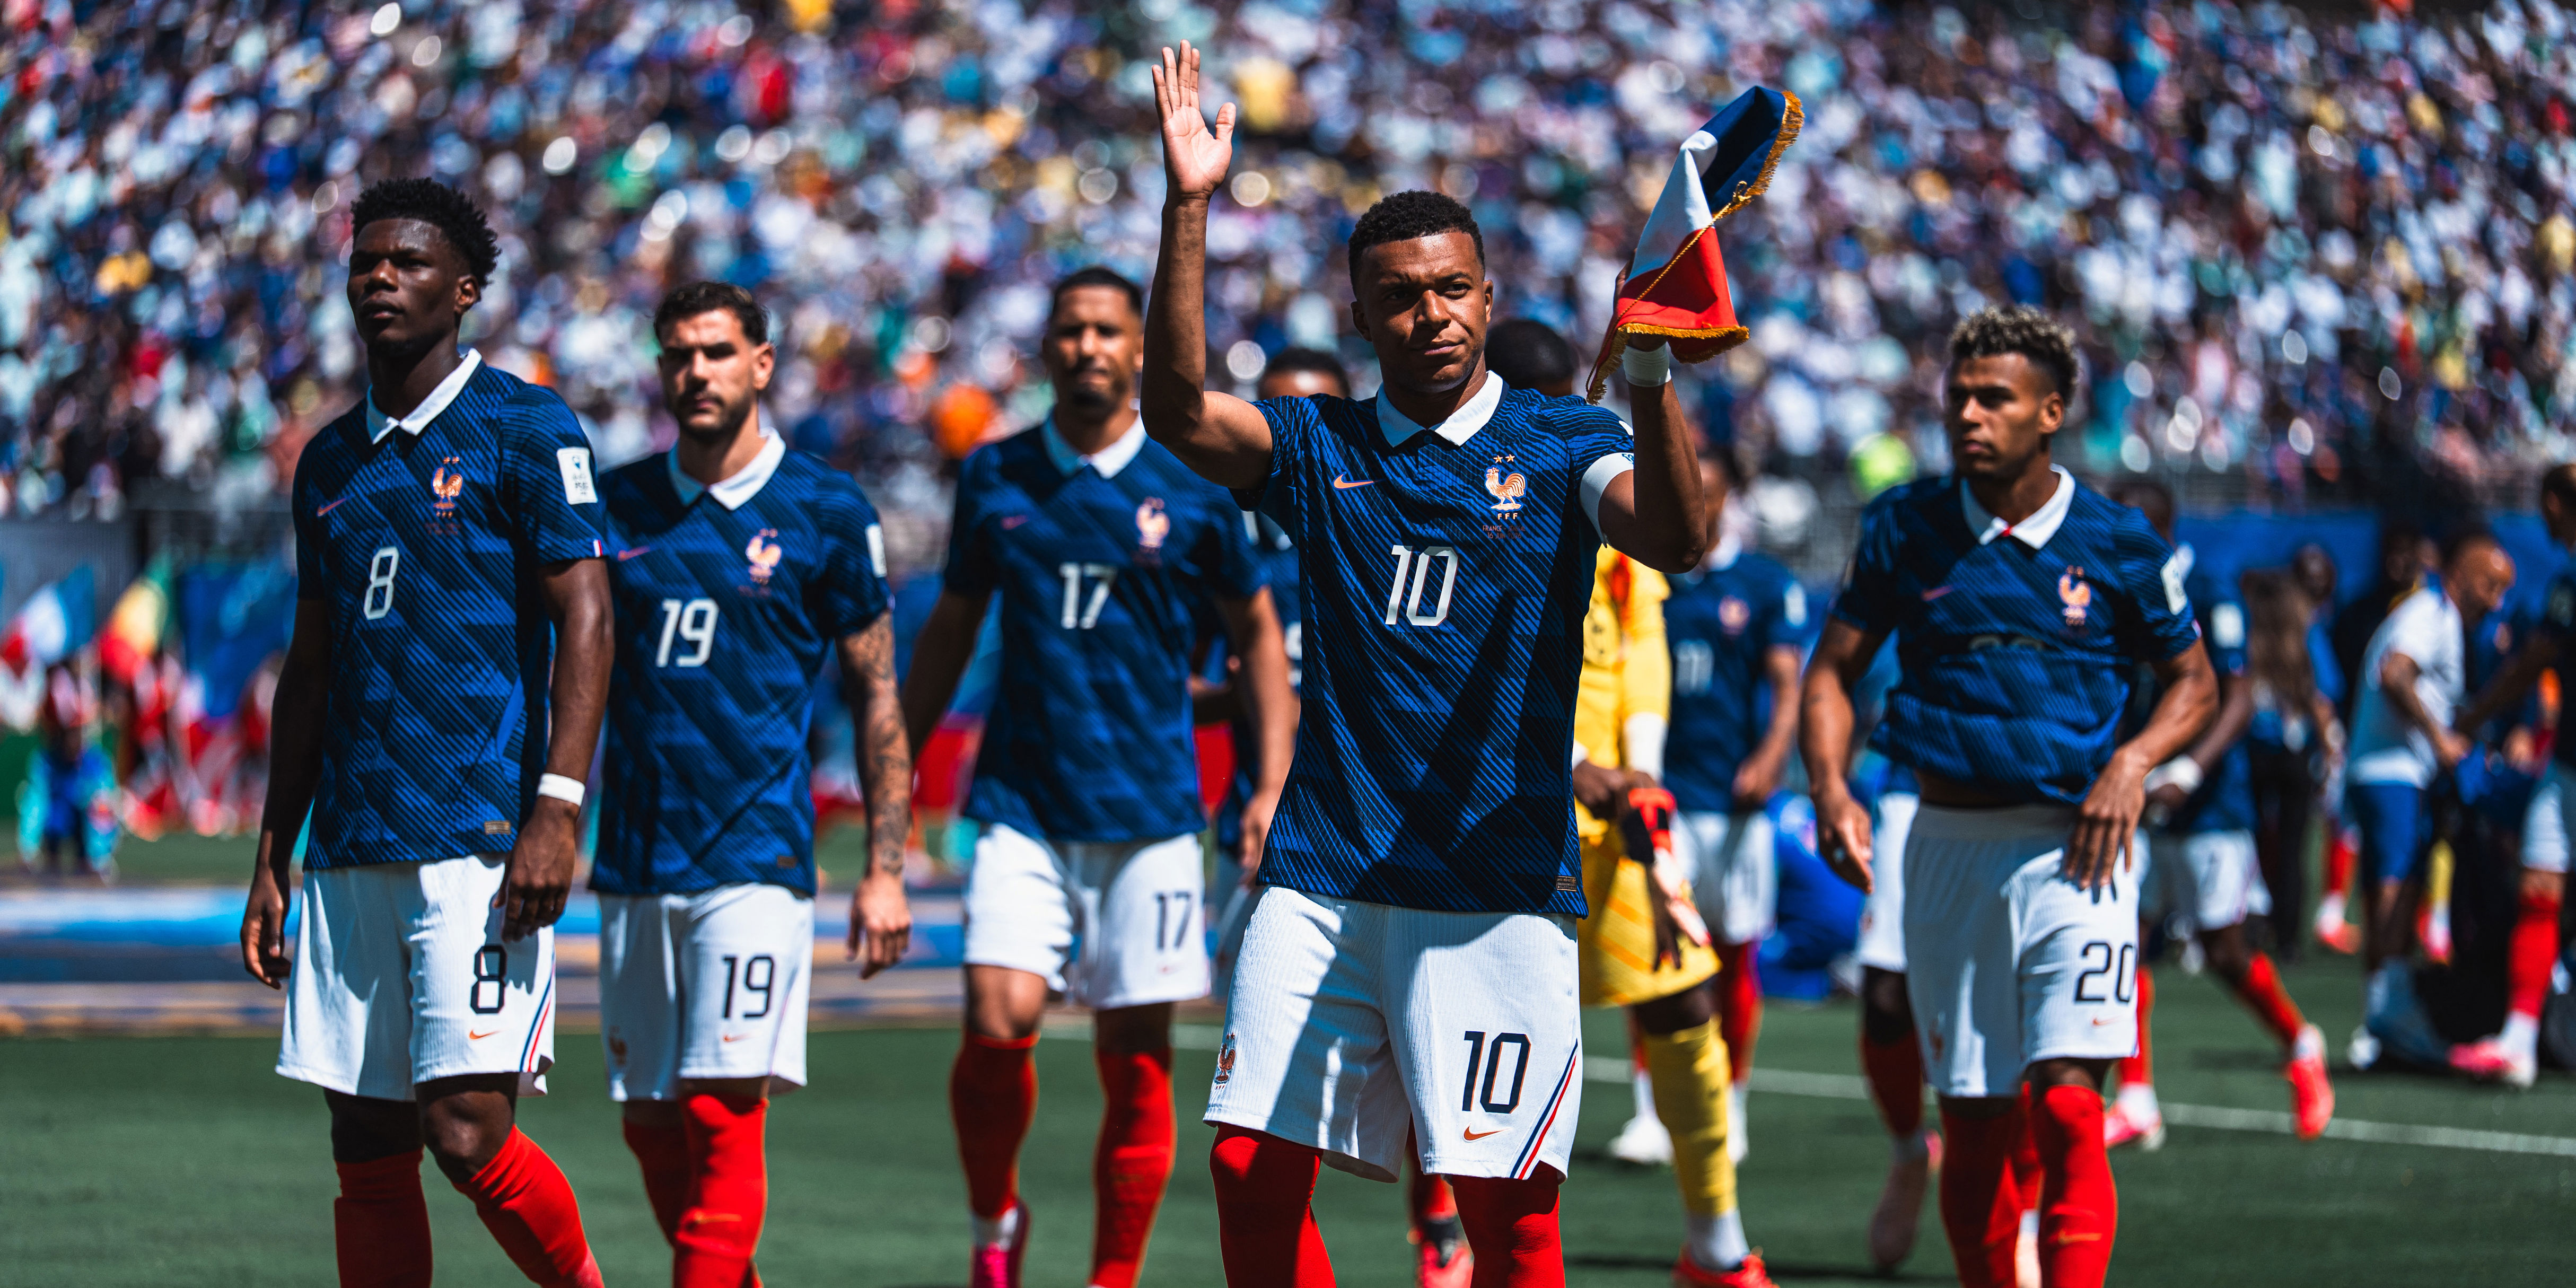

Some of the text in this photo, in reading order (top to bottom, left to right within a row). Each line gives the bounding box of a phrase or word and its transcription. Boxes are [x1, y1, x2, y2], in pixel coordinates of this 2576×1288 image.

[363, 546, 399, 620] 8
[1059, 562, 1117, 629] 17
[1385, 545, 1458, 626] 10
[656, 598, 720, 667] 19
[1154, 891, 1192, 949] 17
[470, 945, 507, 1014] 8
[722, 956, 775, 1018] 19
[2075, 942, 2135, 1003] 20
[1462, 1030, 1531, 1114] 10
